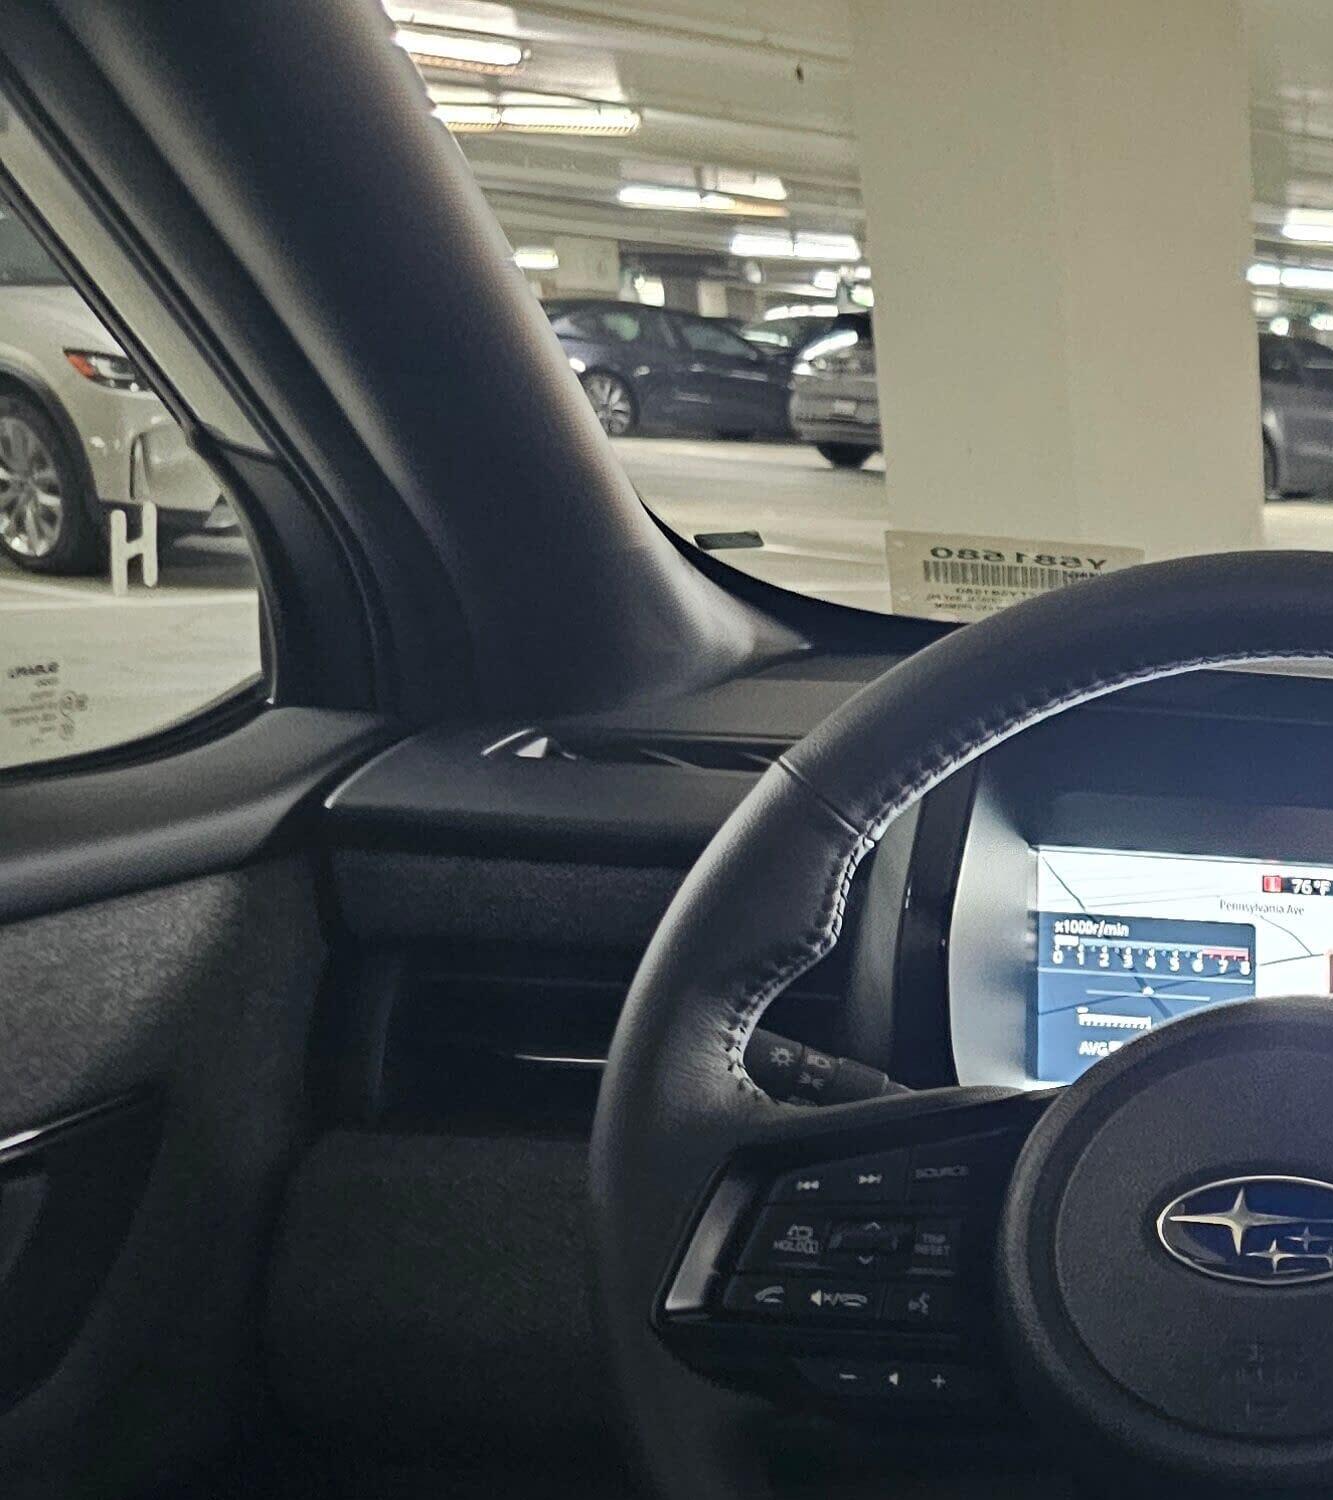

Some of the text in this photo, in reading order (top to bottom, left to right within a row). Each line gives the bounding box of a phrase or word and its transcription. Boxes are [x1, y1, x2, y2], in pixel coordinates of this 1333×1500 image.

[1291, 879, 1331, 896] 76°F
[1220, 899, 1305, 916] Pennsylvania Ave
